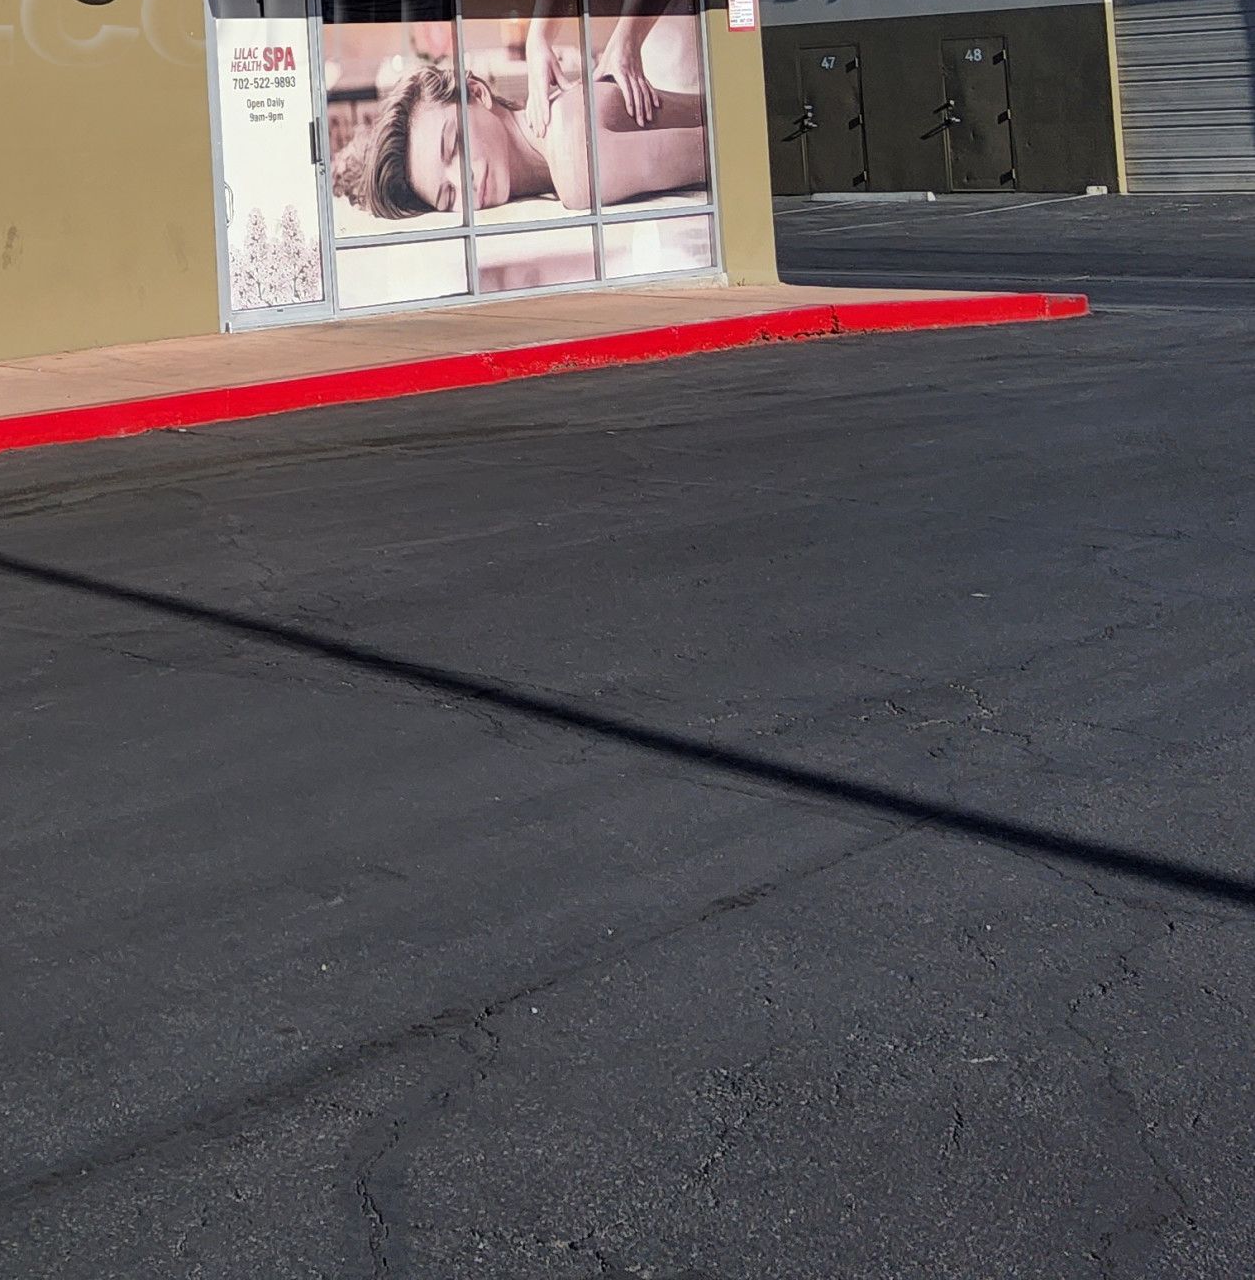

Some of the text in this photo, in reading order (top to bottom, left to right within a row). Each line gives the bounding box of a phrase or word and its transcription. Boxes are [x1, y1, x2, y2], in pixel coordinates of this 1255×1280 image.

[233, 47, 258, 60] LILAC
[262, 46, 296, 72] SPA
[964, 48, 983, 62] 48
[230, 60, 262, 73] HEALTH
[821, 56, 836, 70] 47
[233, 76, 296, 90] 702-522-9893
[246, 98, 285, 110] Open Daily
[249, 112, 284, 122] 9am-9pm
